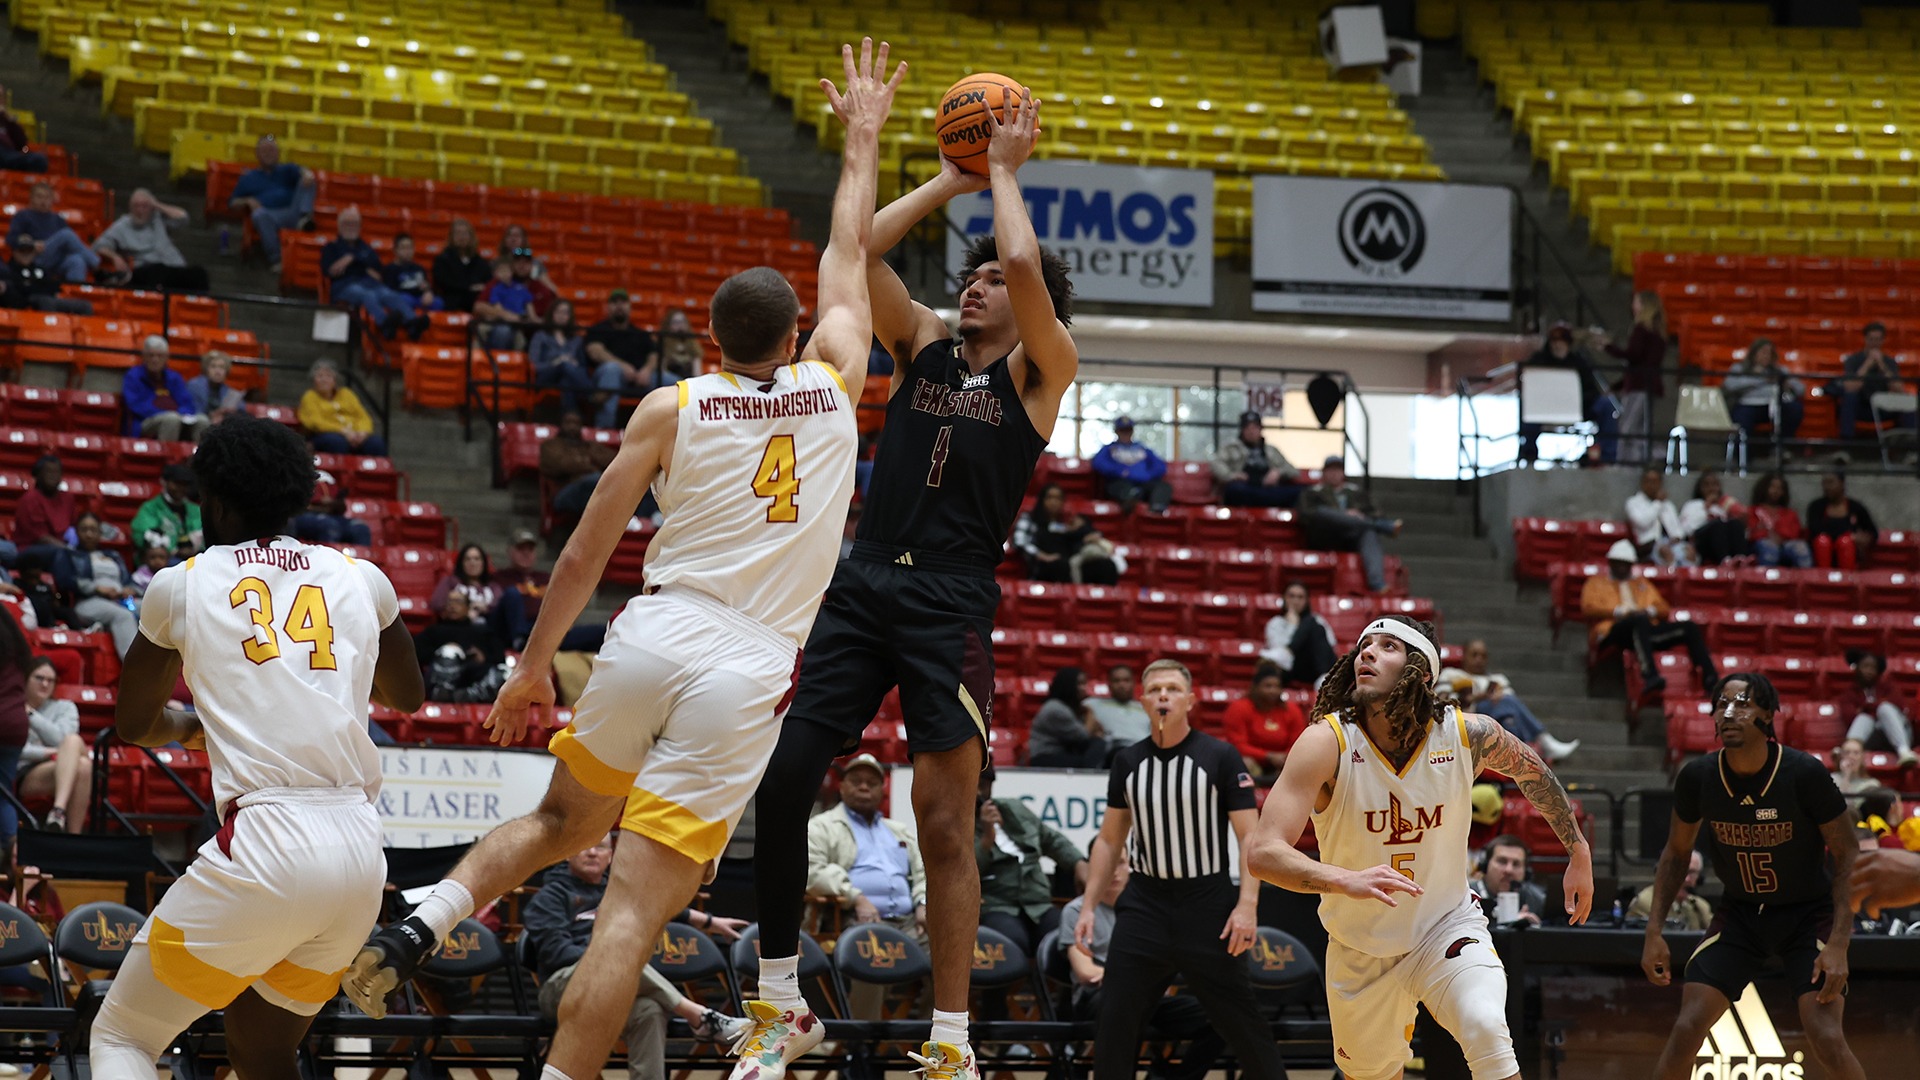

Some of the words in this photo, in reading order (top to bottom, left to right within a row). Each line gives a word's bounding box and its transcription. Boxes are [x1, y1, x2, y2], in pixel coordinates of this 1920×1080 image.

[943, 90, 986, 116] NCAA
[1059, 247, 1195, 289] nergy
[962, 374, 990, 390] SBC
[1247, 387, 1283, 412] 106
[699, 387, 838, 421] METSKHVARISHVILI
[948, 389, 1003, 427] STATE
[926, 425, 953, 488] 4
[751, 434, 801, 523] 4
[229, 576, 337, 671] 34
[1429, 749, 1455, 765] SBC
[1022, 796, 1108, 829] ADE
[1364, 791, 1444, 845] ULM
[1710, 821, 1752, 848] TEXAS
[1751, 821, 1792, 848] STATE
[1391, 852, 1415, 882] 5
[1737, 852, 1778, 893] 15
[82, 910, 138, 951] ULM
[856, 930, 907, 968] ULM
[1690, 1053, 1804, 1080] didas
